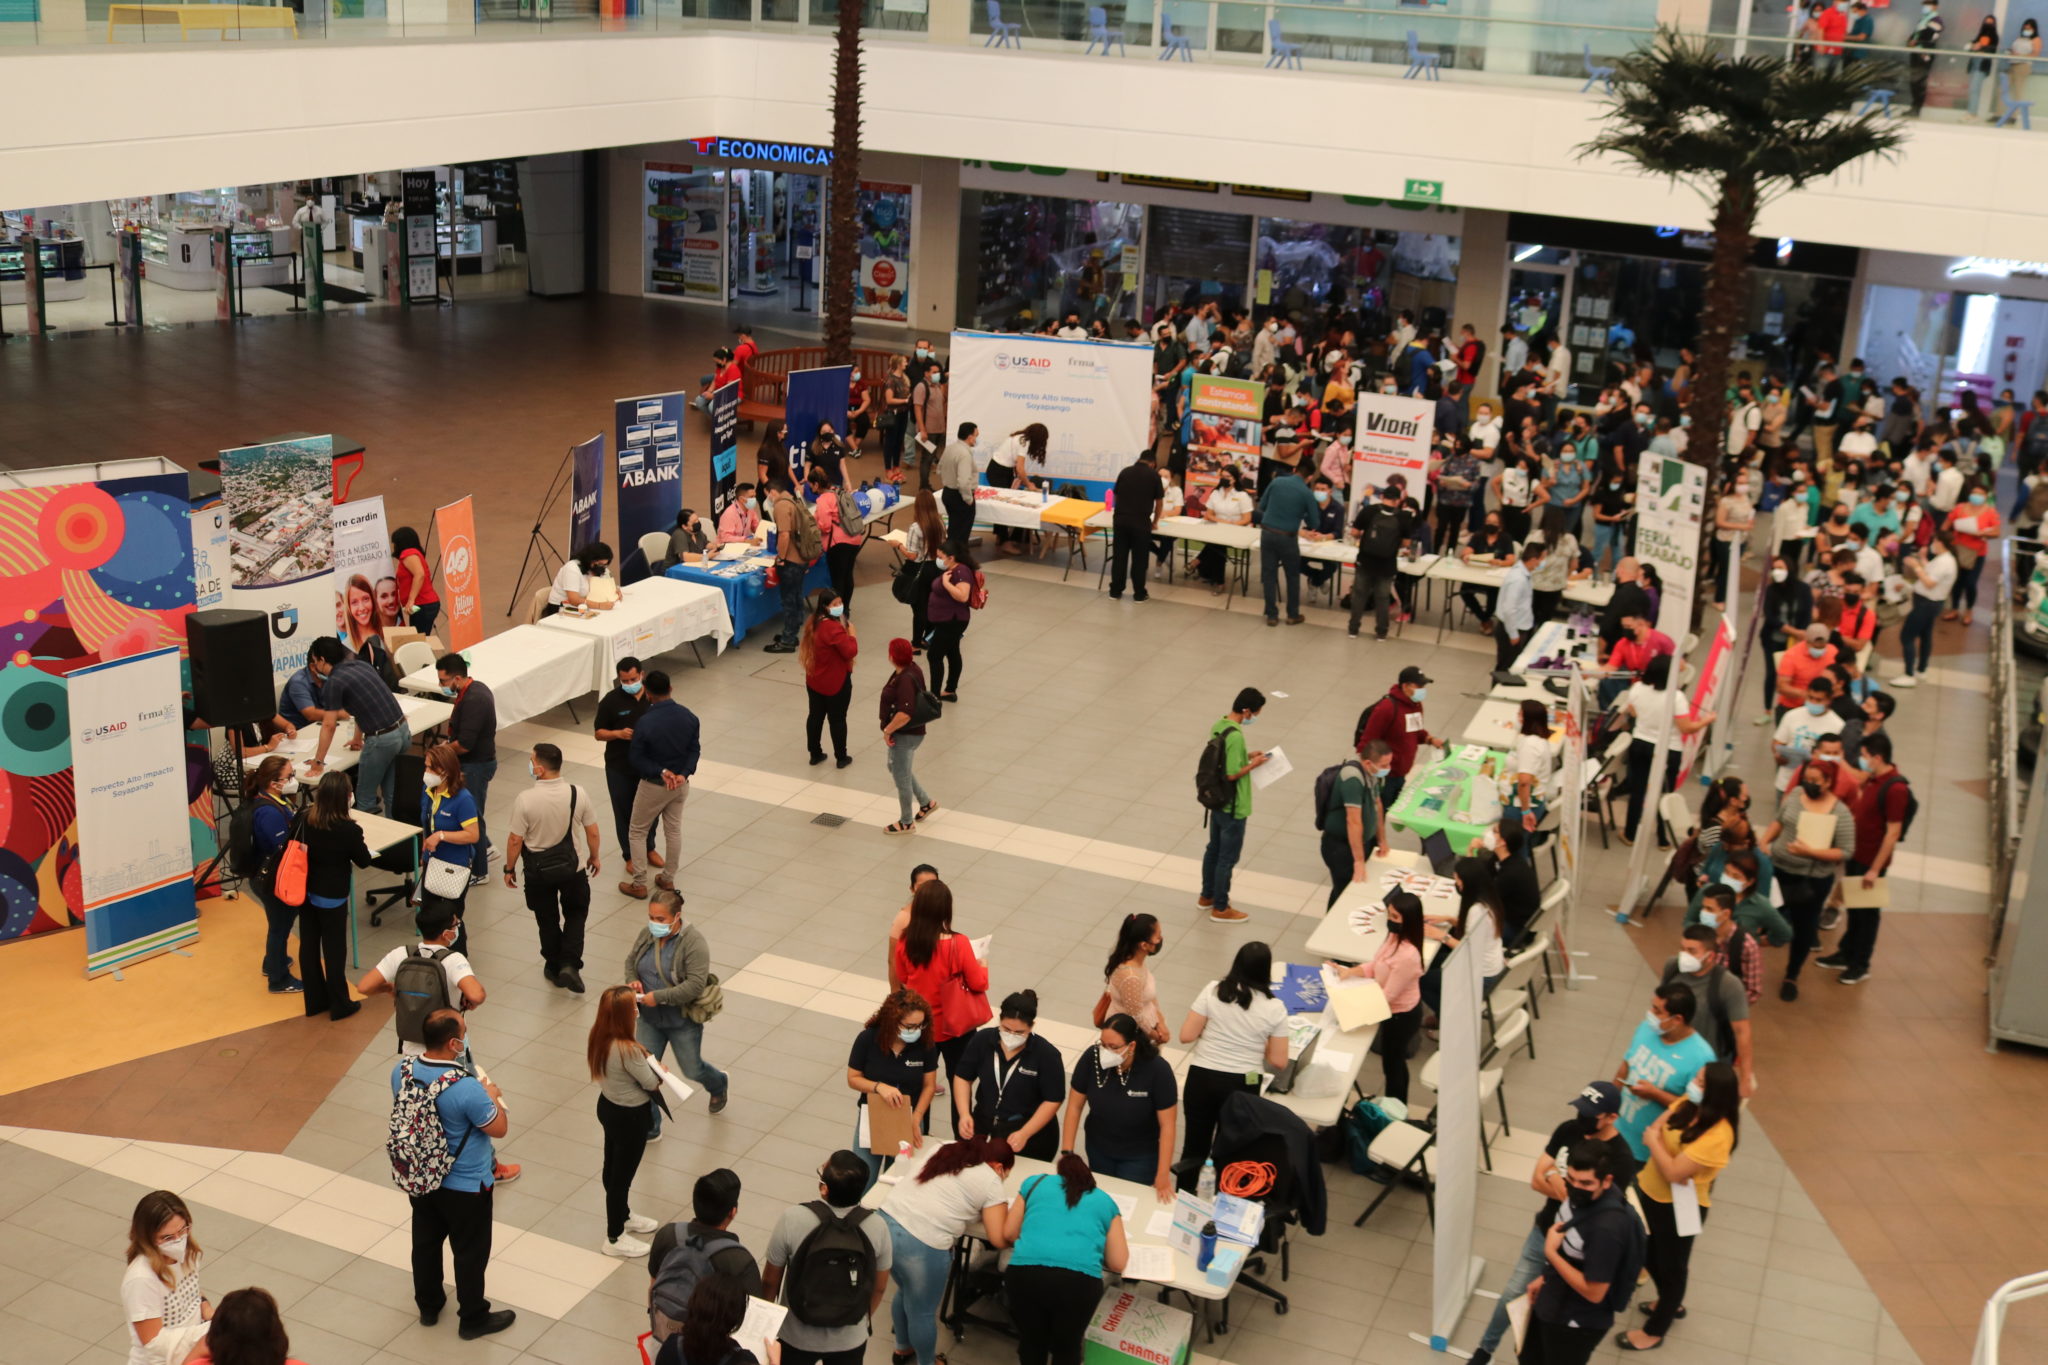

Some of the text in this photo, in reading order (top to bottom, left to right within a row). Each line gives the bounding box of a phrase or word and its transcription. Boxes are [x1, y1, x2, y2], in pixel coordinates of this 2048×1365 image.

[406, 177, 430, 189] Hoy
[1012, 356, 1051, 368] USAID
[1003, 390, 1094, 405] Proyecto Alto Impacto
[1025, 401, 1071, 412] Soyapango
[789, 441, 807, 469] ti
[622, 465, 679, 488] ABANK
[572, 490, 598, 515] ABANK
[335, 511, 378, 528] rre cardin
[1639, 527, 1672, 548] FERIA
[354, 541, 380, 554] NUESTRO
[1638, 541, 1693, 570] TRABAJO
[357, 550, 383, 564] TRABAJO
[208, 577, 221, 592] DE
[95, 721, 127, 736] USAID
[90, 766, 174, 794] Proyecto Alto Impacto
[112, 781, 154, 798] Soyapango
[1628, 1044, 1677, 1088] JUST
